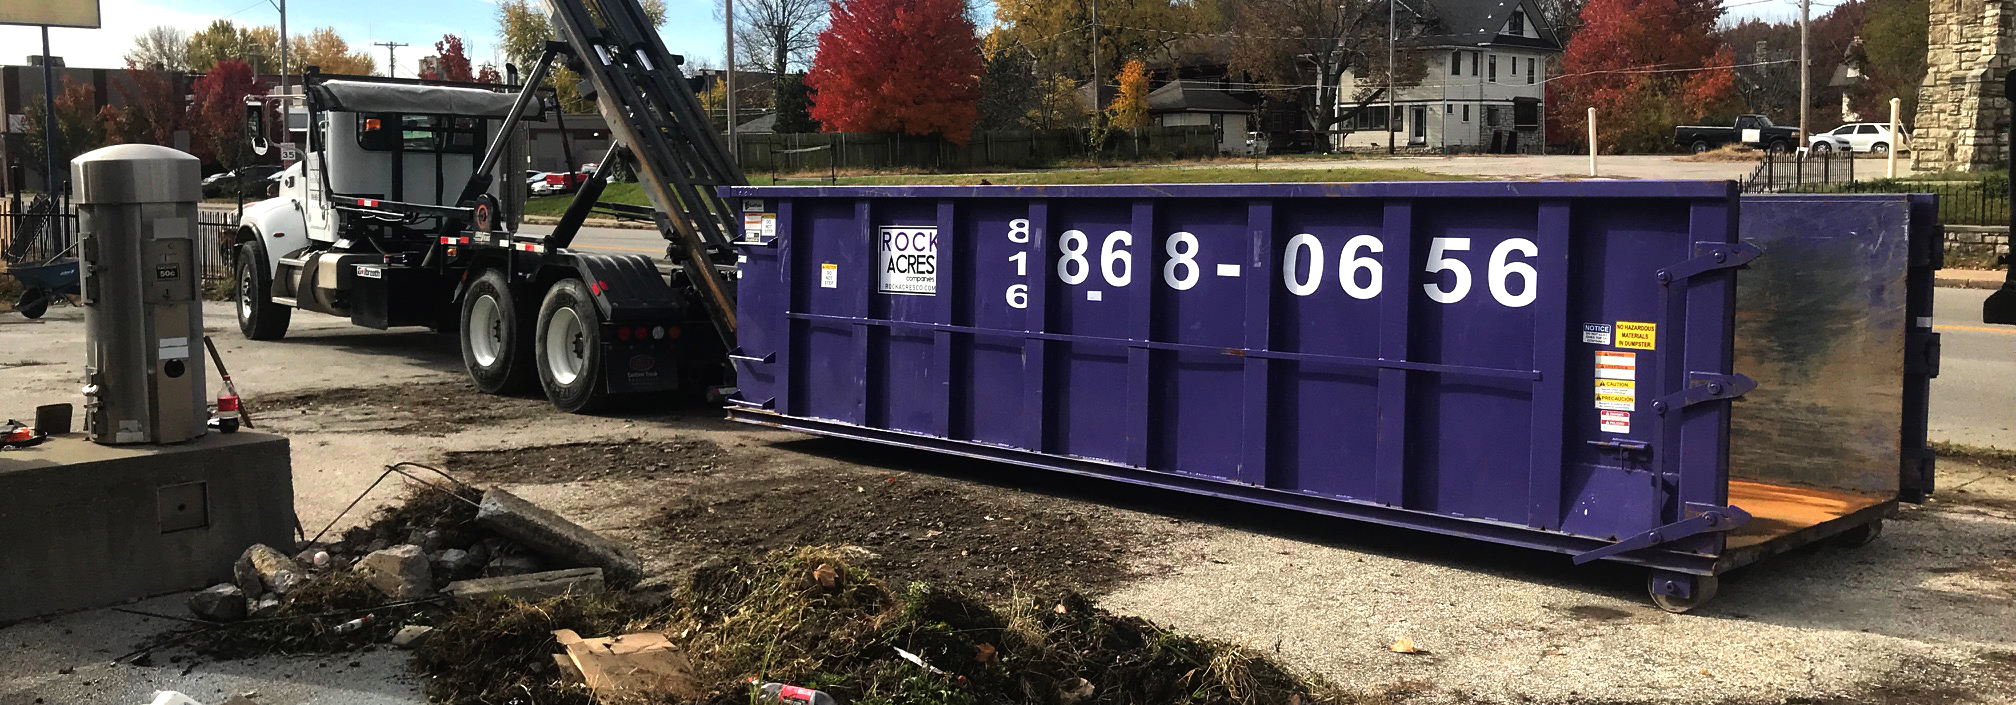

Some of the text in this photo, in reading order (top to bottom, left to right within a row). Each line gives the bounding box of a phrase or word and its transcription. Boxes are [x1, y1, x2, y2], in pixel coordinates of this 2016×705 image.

[282, 151, 294, 159] 35
[882, 231, 938, 252] ROCK
[886, 254, 936, 275] ACRES
[1585, 324, 1610, 333] NOTICE
[1624, 324, 1655, 332] HAZARDOUS
[1621, 332, 1649, 340] MATERIALS
